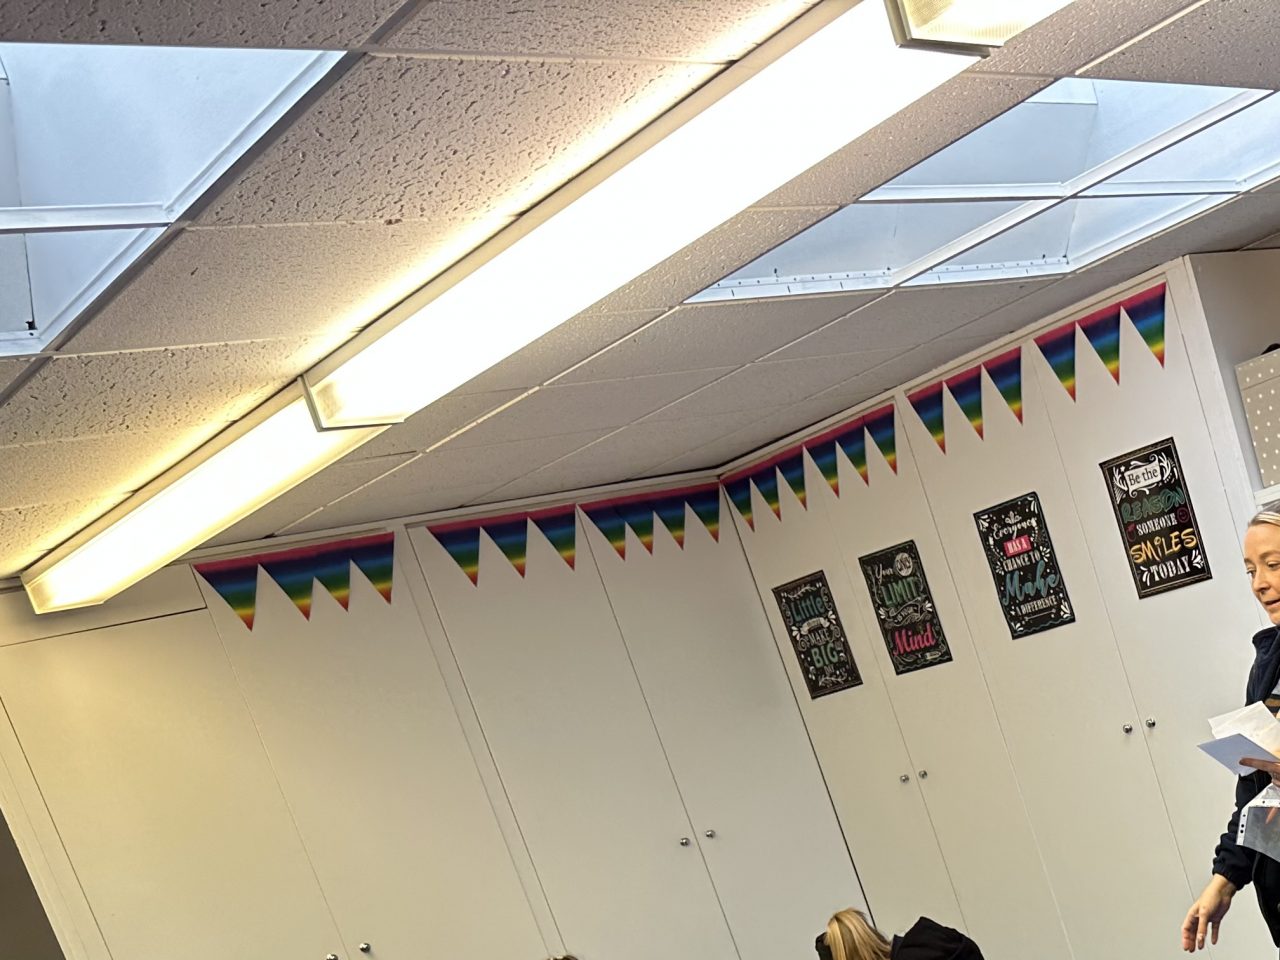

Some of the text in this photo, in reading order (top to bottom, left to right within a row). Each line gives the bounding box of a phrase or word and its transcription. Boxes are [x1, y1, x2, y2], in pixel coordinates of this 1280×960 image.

[1127, 467, 1159, 487] Be the
[1121, 486, 1186, 523] REASON
[1136, 512, 1178, 536] SOMEONE
[1007, 540, 1022, 554] HAS
[1002, 550, 1041, 572] CHANCE TO
[1150, 555, 1191, 582] TODAY
[875, 563, 894, 585] Your
[1002, 560, 1060, 606] Make
[880, 577, 919, 606] LIMIT
[790, 595, 825, 621] Little
[1020, 596, 1057, 615] DIFFERENCE
[808, 628, 831, 644] MAKE
[893, 622, 936, 656] Mind
[811, 643, 838, 668] BIG
